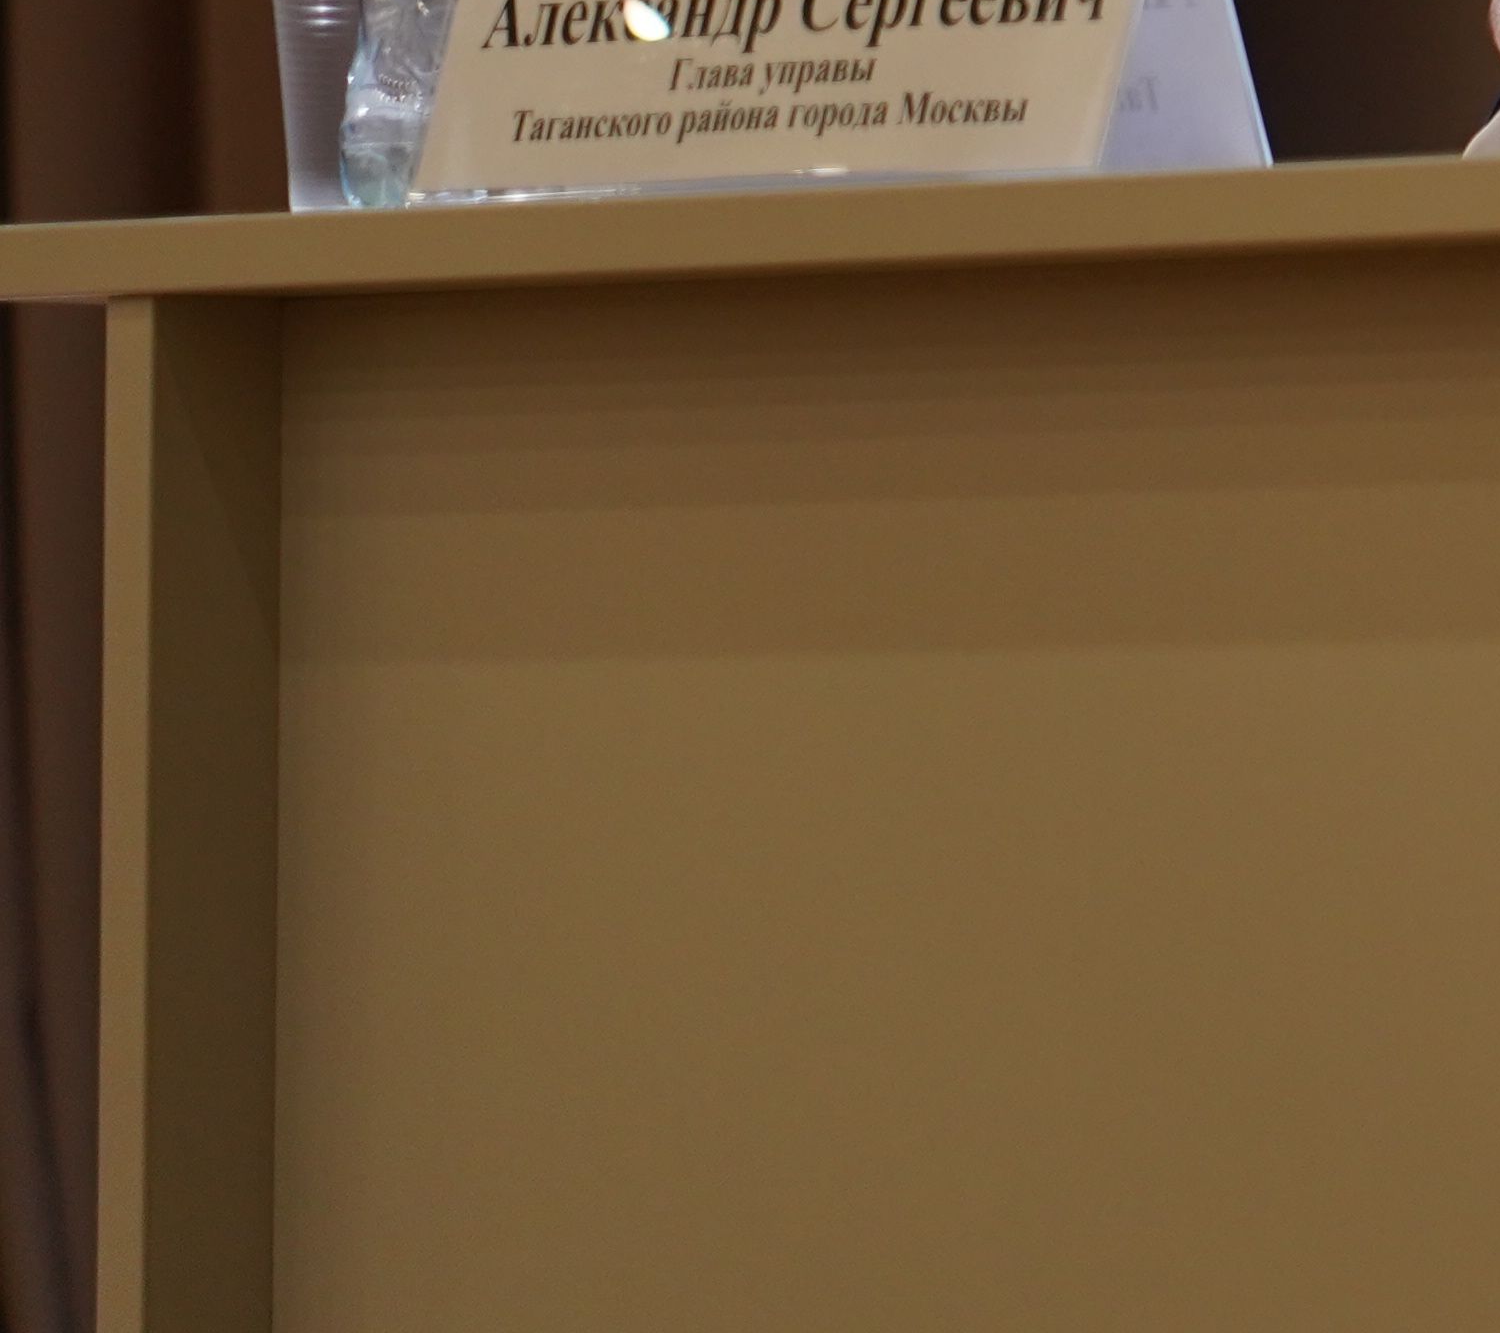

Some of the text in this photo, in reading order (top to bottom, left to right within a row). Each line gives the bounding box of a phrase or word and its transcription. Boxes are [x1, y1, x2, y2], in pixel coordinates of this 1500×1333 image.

[669, 55, 878, 95] Глава управы
[512, 90, 1029, 145] Таганского района города Москвы
